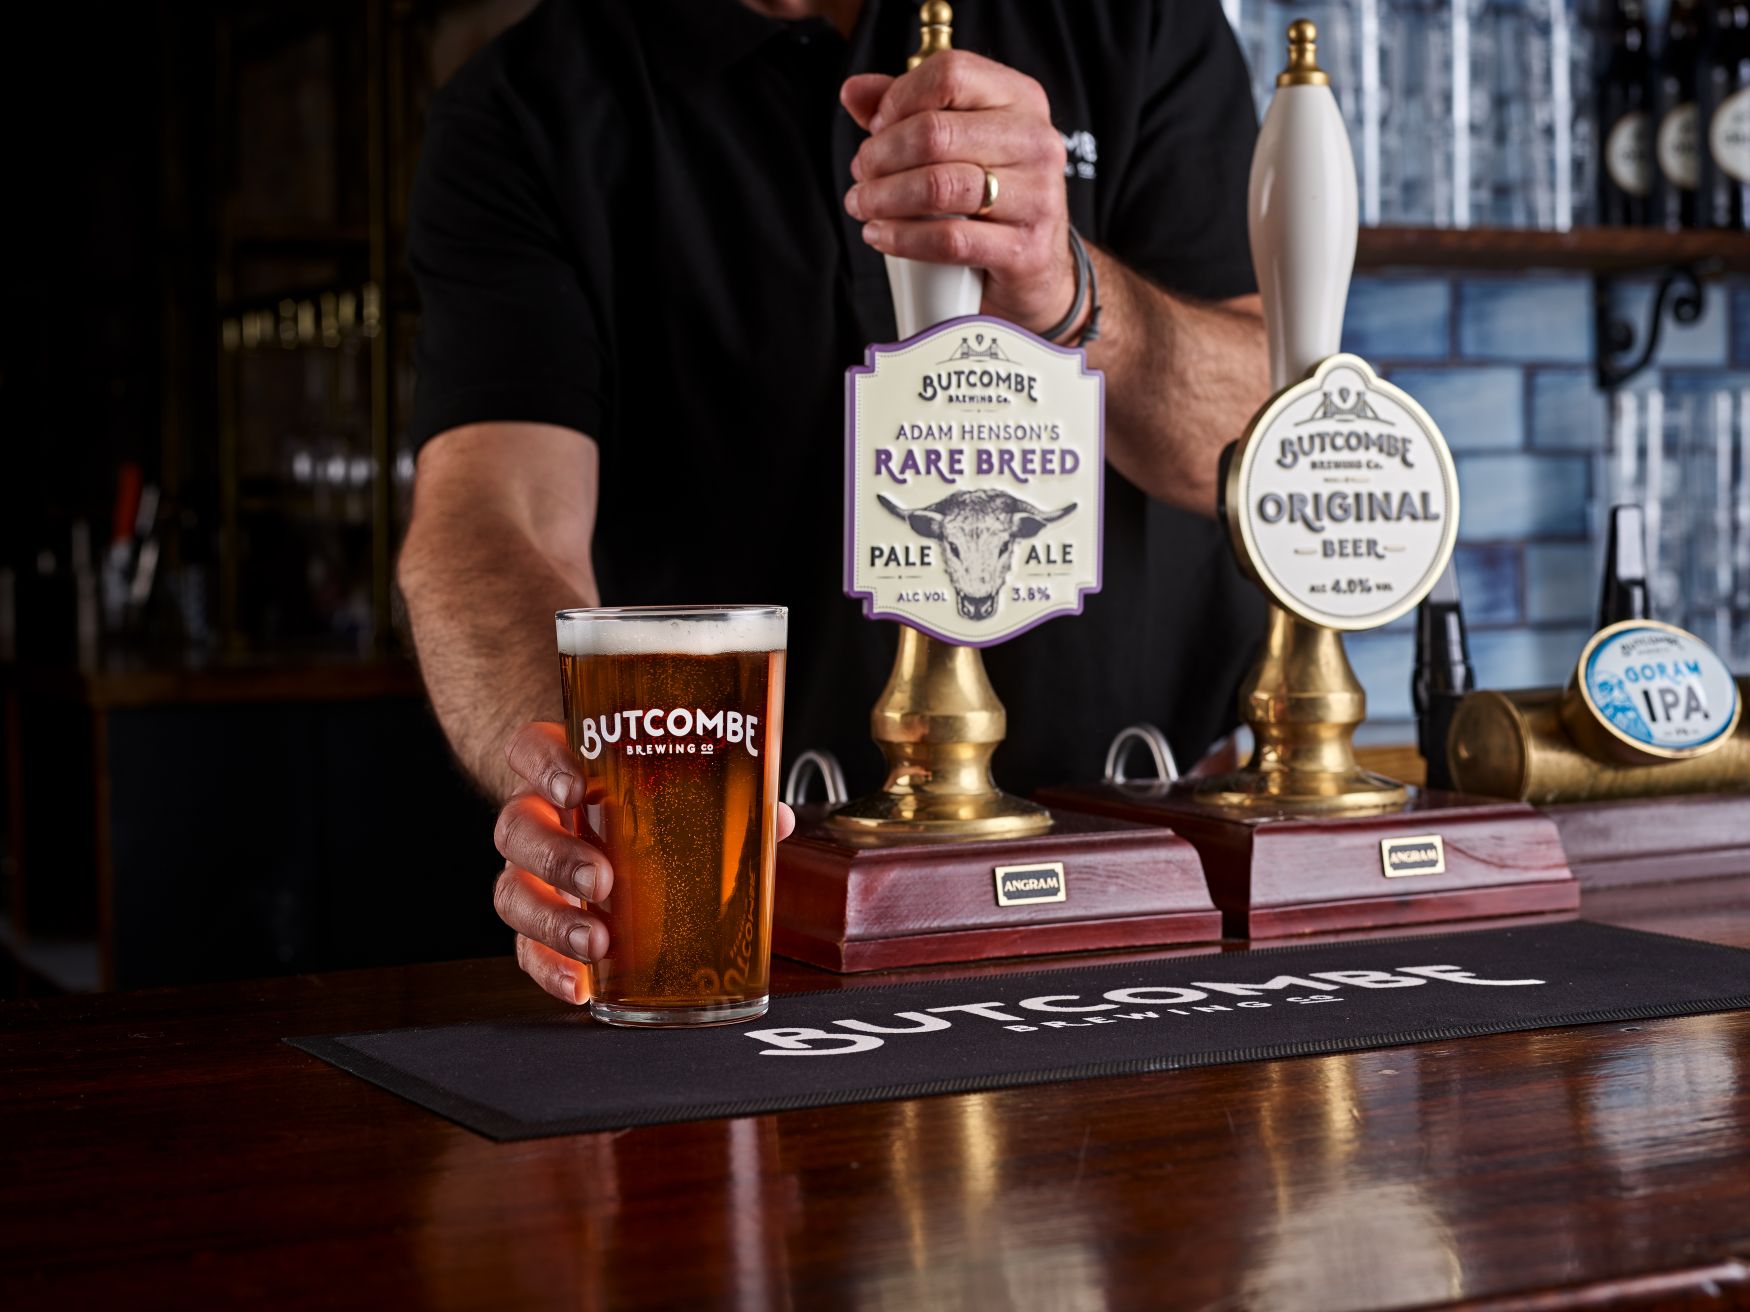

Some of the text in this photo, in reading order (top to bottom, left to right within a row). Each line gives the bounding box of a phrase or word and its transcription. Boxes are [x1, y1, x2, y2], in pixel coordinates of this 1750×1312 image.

[918, 370, 1038, 402] BUTCOMBE
[948, 395, 993, 403] BREWING
[897, 423, 1060, 440] ADAM HENSON'S
[1276, 431, 1414, 469] BUTCOMBE
[874, 449, 1080, 484] RARE BREED
[1258, 492, 1440, 533] ORIGINAL
[870, 544, 1073, 567] PALE ALE
[1322, 539, 1386, 559] BEER
[897, 588, 1051, 602] ALC VOL 3.8%
[1331, 579, 1372, 594] 4.0%
[580, 708, 759, 760] BUTCOMBE
[626, 744, 696, 756] BREWING
[1004, 877, 1059, 892] ANGRAM
[744, 964, 1546, 1056] BUTCOMBE
[1003, 1002, 1273, 1032] BREWING
